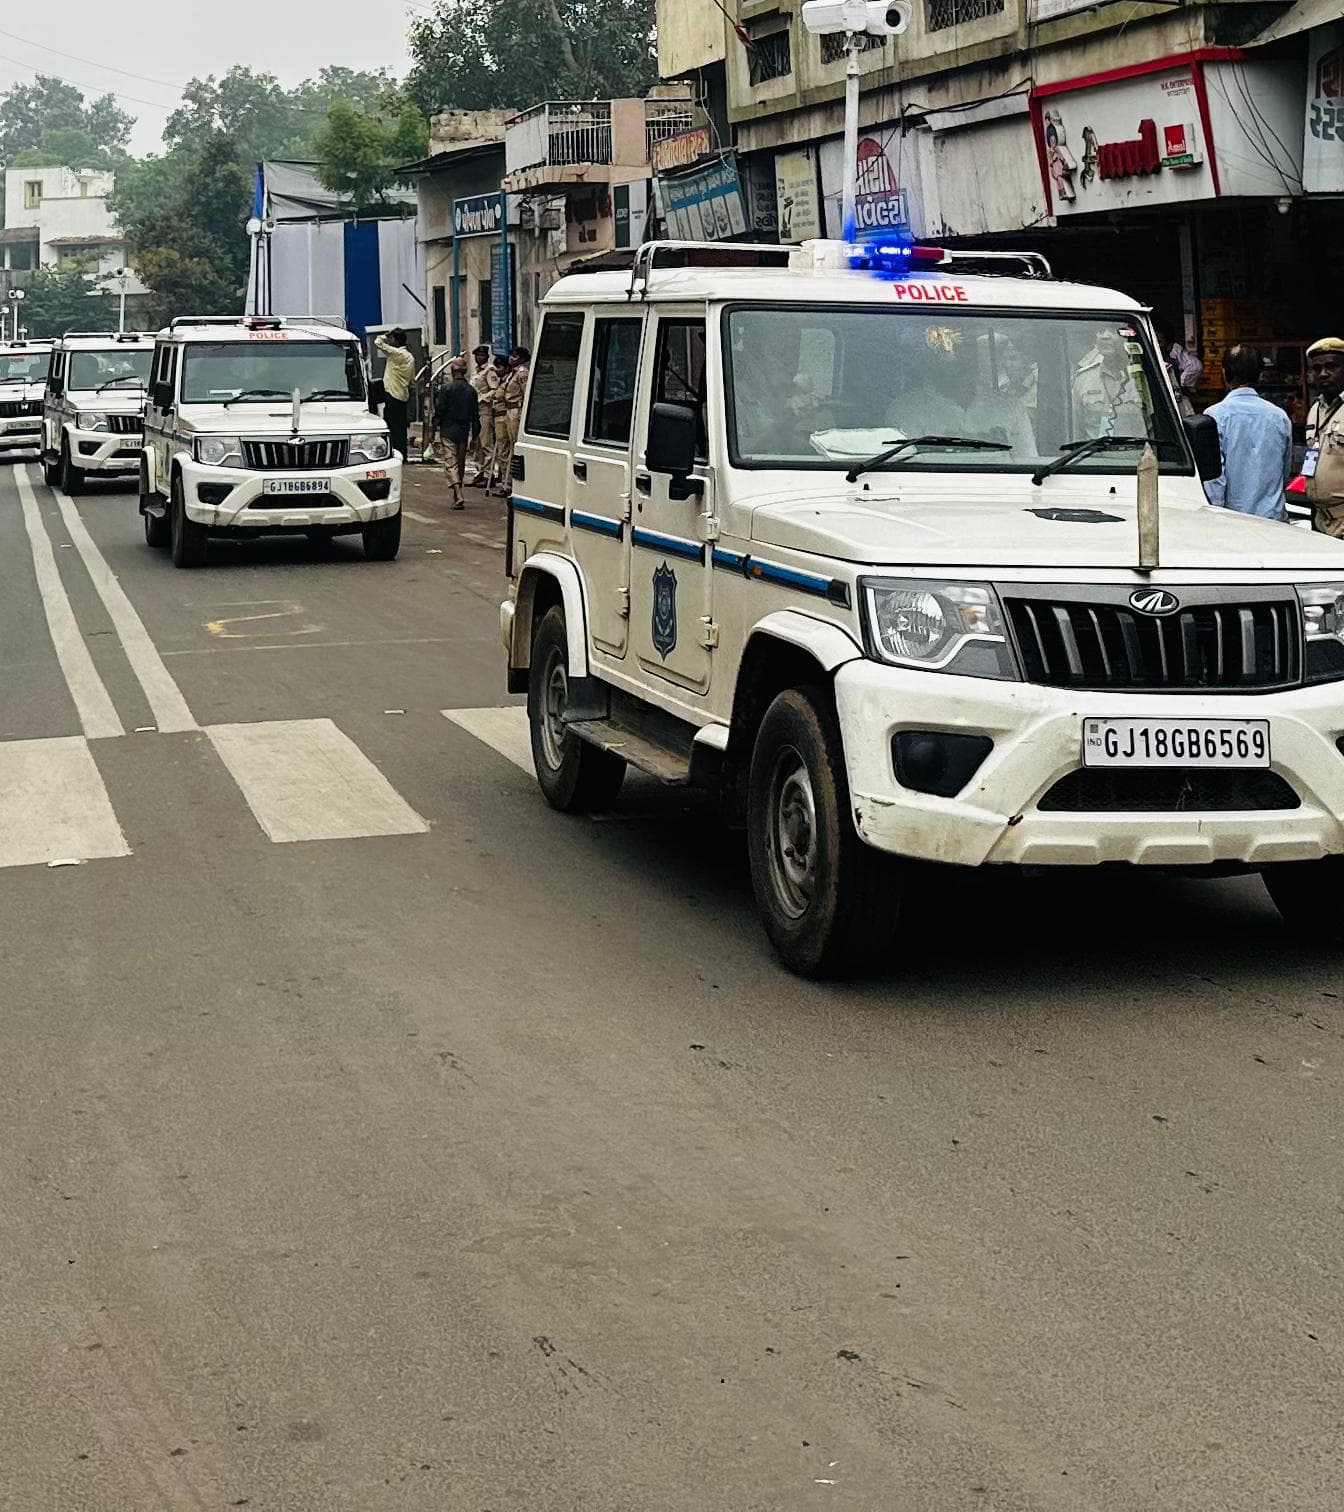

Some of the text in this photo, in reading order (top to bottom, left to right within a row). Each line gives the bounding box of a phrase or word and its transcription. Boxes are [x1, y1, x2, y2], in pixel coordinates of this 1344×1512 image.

[893, 284, 969, 302] POLICE
[249, 331, 288, 340] POLICE
[1105, 727, 1266, 759] GJ18GB6569
